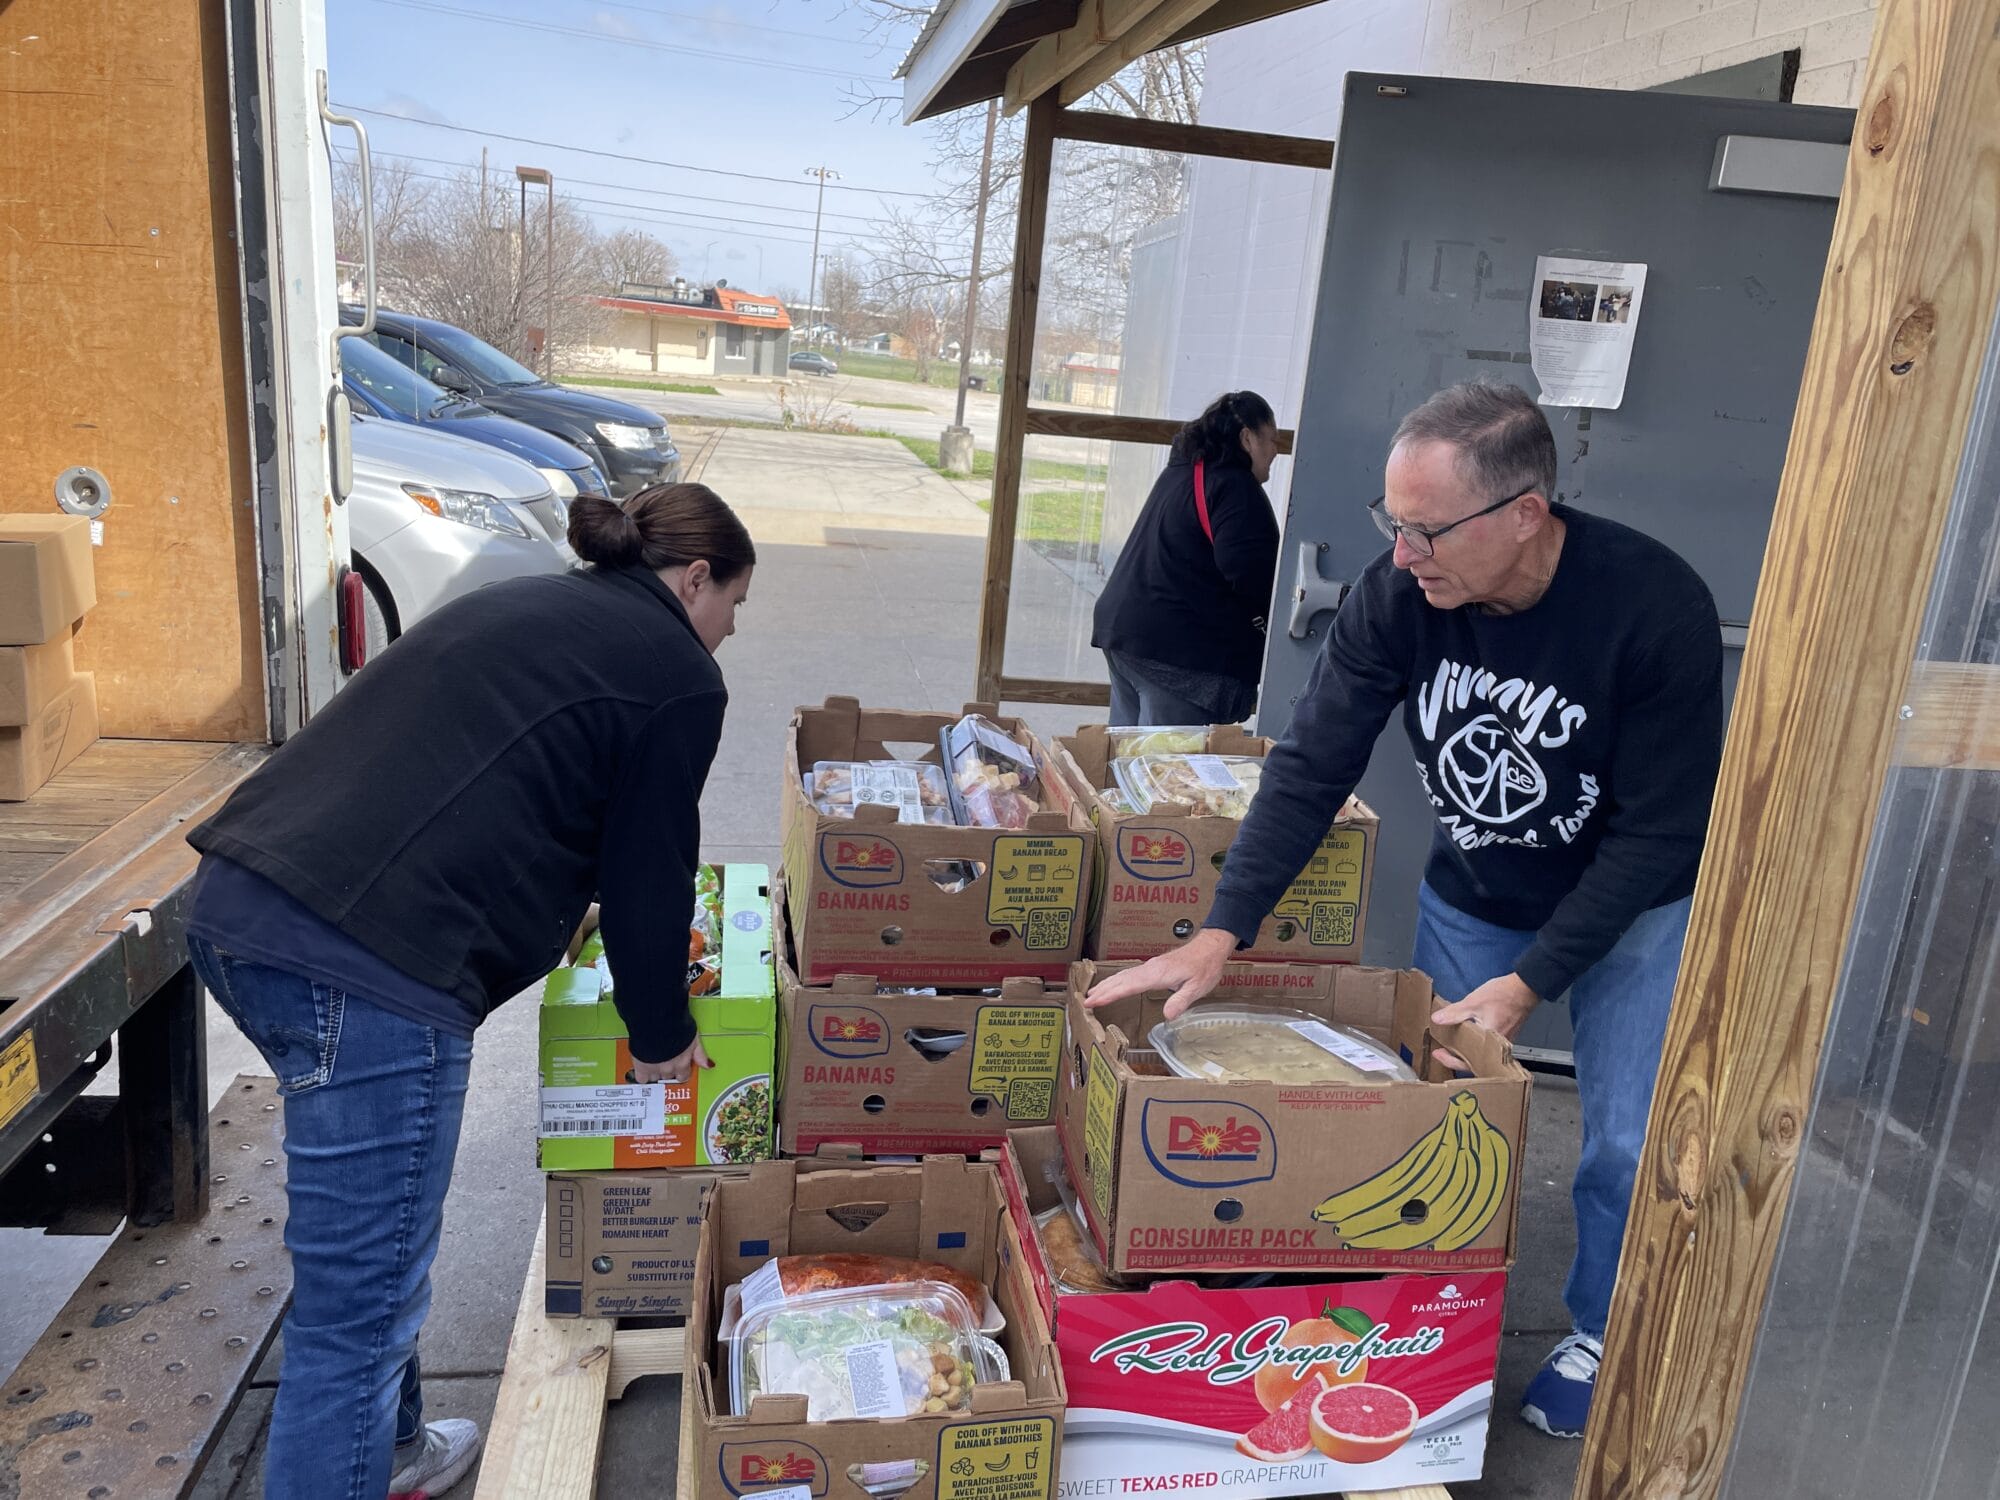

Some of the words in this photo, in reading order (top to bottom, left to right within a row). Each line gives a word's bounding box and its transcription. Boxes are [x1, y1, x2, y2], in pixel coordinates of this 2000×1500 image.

[835, 842, 896, 865] Dole
[1131, 835, 1185, 858] Dole
[1113, 884, 1199, 904] BANANAS
[1292, 888, 1306, 896] AUX
[817, 891, 910, 912] BANANAS
[892, 967, 940, 978] PREMIUM
[942, 967, 990, 978] BANANAS
[1220, 974, 1279, 987] ONSUMER
[1283, 974, 1314, 988] PACK
[823, 1016, 881, 1039] Dole
[804, 1066, 895, 1085] BANANAS
[1279, 1090, 1320, 1099] HANDLE
[1323, 1090, 1353, 1100] WITH
[1355, 1091, 1384, 1100] CARE
[1168, 1116, 1261, 1154] Dole
[876, 1139, 923, 1149] PREMIUM
[925, 1139, 973, 1149] BANANAS
[603, 1187, 630, 1196] GREEN
[632, 1187, 651, 1195] LEAF
[603, 1199, 630, 1207] GREEN
[603, 1207, 634, 1215] W/DATE
[602, 1217, 628, 1226] BETTER
[629, 1217, 658, 1225] BURGER
[602, 1230, 640, 1239] ROMAINE
[642, 1229, 669, 1238] HEART
[1129, 1228, 1254, 1248] CONSUMER
[1260, 1228, 1318, 1248] PACK
[632, 1260, 669, 1269] PRODUCT
[671, 1260, 681, 1268] OF
[1131, 1255, 1187, 1266] PREMIUM
[1190, 1254, 1245, 1264] BANANAS
[1262, 1255, 1318, 1265] PREMIUM
[1321, 1254, 1375, 1264] BANANAS
[1392, 1254, 1447, 1265] PREMIUM
[1449, 1253, 1502, 1264] BANANAS
[627, 1273, 677, 1281] SUBSTITUTE
[596, 1296, 637, 1311] Simply
[639, 1296, 683, 1309] Singles
[1412, 1298, 1486, 1313] PARAMOUNT
[1090, 1319, 1232, 1376] Red
[1208, 1316, 1445, 1384] Grapefruit
[957, 1429, 979, 1439] COOL
[982, 1427, 997, 1436] OFF
[1000, 1425, 1021, 1435] WITH
[1024, 1424, 1041, 1432] OUR
[1426, 1435, 1460, 1443] TEXAS
[955, 1440, 991, 1449] BANANA
[993, 1433, 1042, 1446] SMOOTHIES
[741, 1452, 815, 1480] Dole
[1058, 1478, 1117, 1498] SWEET
[1120, 1474, 1179, 1493] TEXAS
[1182, 1471, 1218, 1488] RED
[1221, 1462, 1329, 1486] GRAPEFRUIT
[954, 1488, 975, 1497] AVEC
[977, 1485, 993, 1494] NOS
[995, 1481, 1034, 1493] BOISSONS
[1009, 1489, 1042, 1500] BANANE
